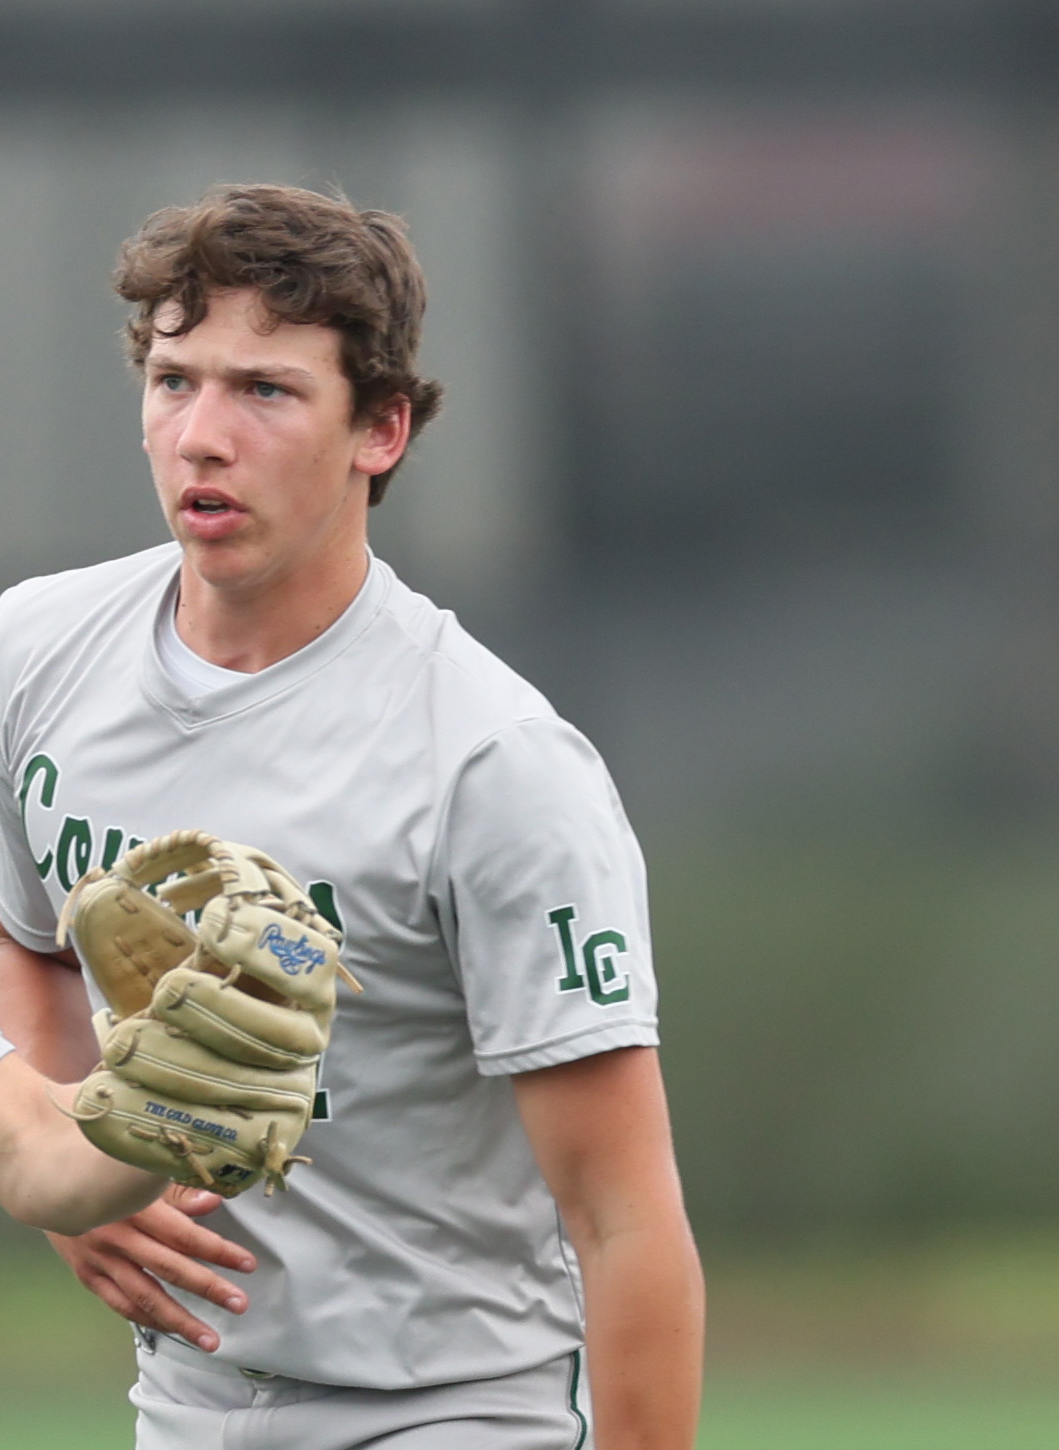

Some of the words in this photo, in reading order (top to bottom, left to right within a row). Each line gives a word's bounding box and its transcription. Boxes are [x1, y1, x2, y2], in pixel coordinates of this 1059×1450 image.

[544, 902, 630, 1009] LC
[144, 1101, 166, 1117] THE
[166, 1108, 192, 1125] GOLD
[192, 1118, 224, 1138] GLOVE
